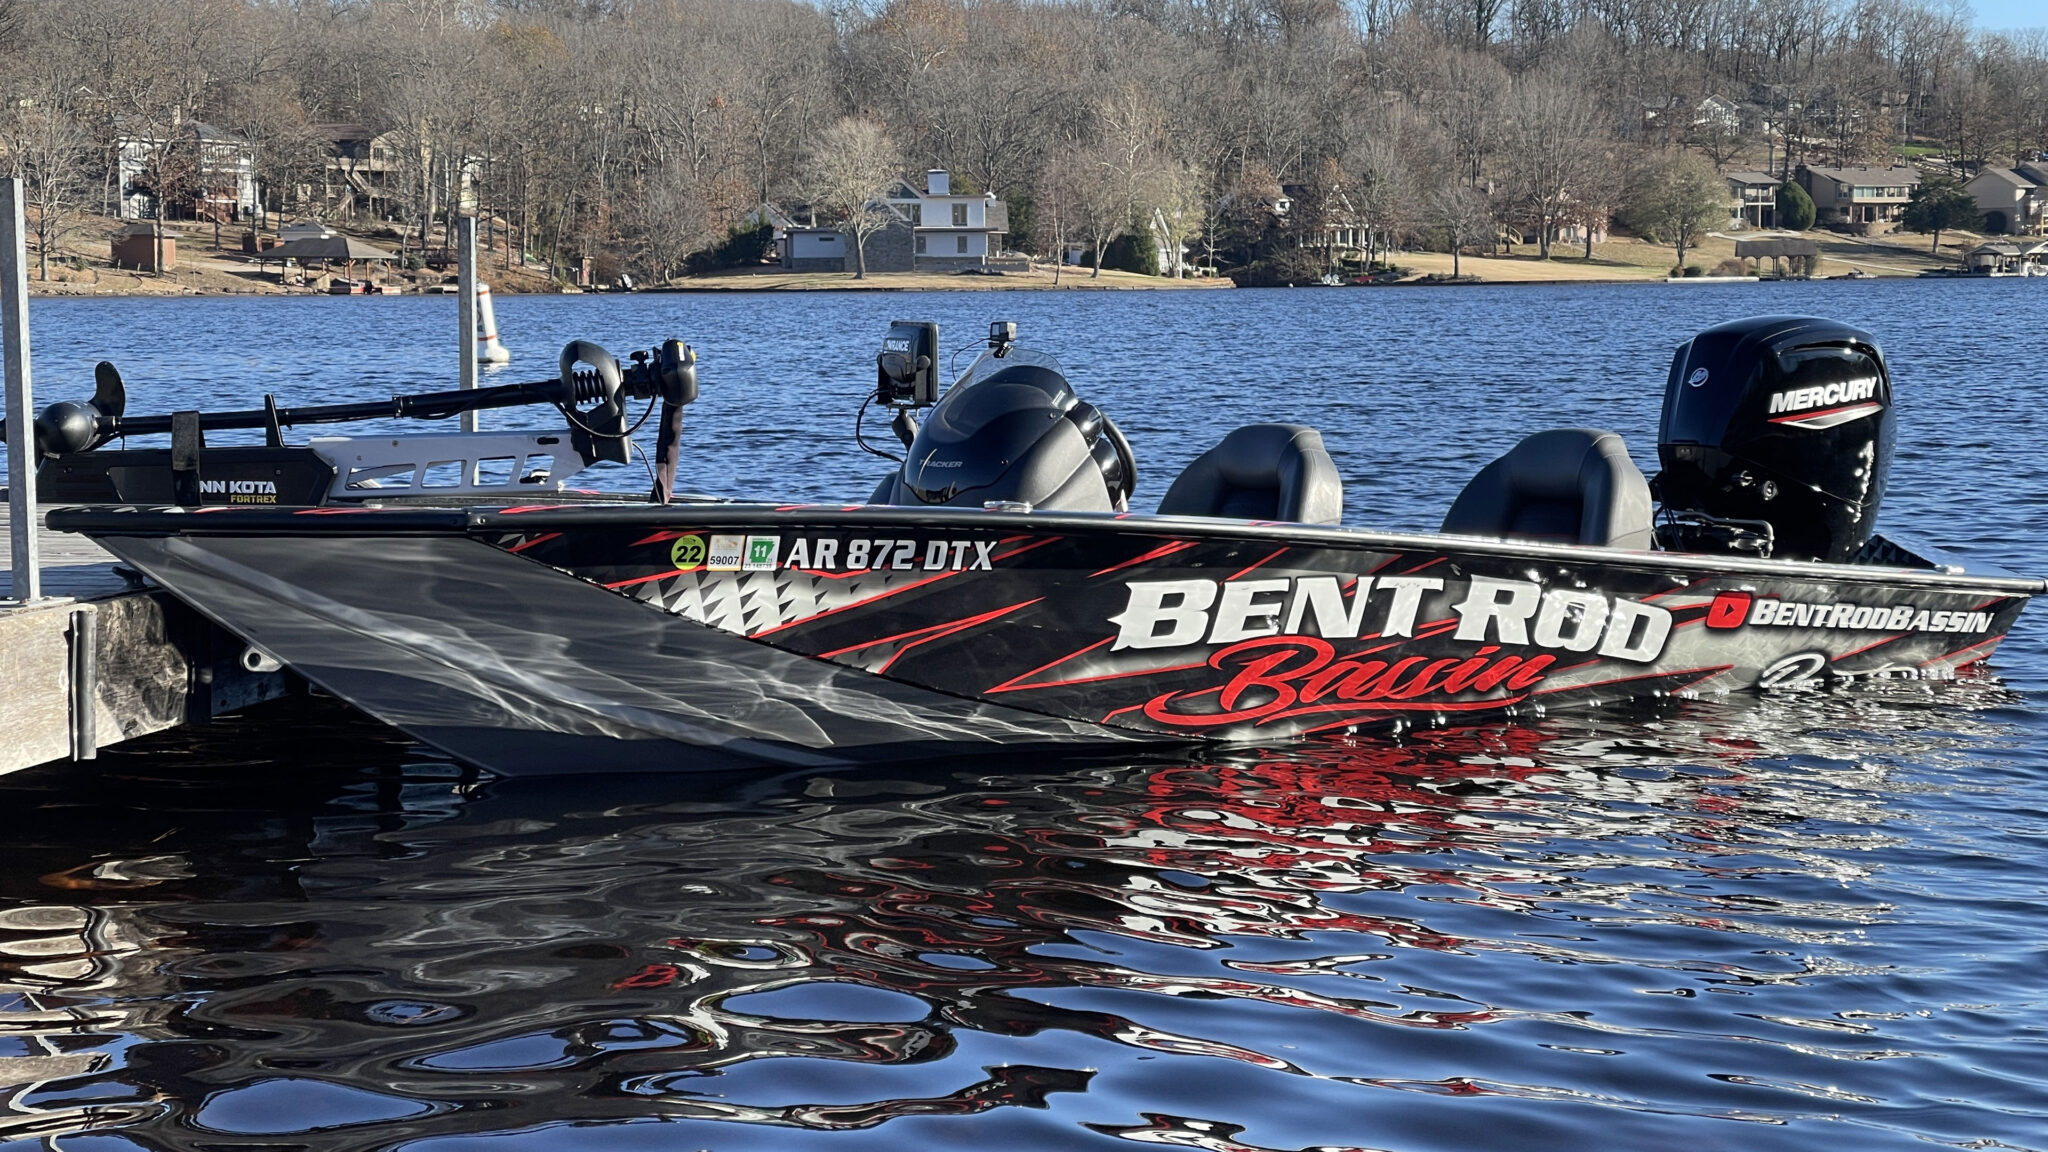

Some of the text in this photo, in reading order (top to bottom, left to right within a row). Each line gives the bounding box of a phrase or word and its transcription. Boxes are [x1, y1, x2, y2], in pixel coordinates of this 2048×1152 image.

[1769, 377, 1877, 414] MERCURY
[200, 480, 277, 494] NN KOTA
[230, 494, 277, 504] FORTREX
[675, 545, 702, 563] 22
[709, 555, 740, 565] 59007
[754, 545, 768, 558] 11
[784, 538, 997, 570] AR 872 DTX
[1107, 574, 1674, 663] BENT ROD
[1144, 636, 1557, 726] Bassin
